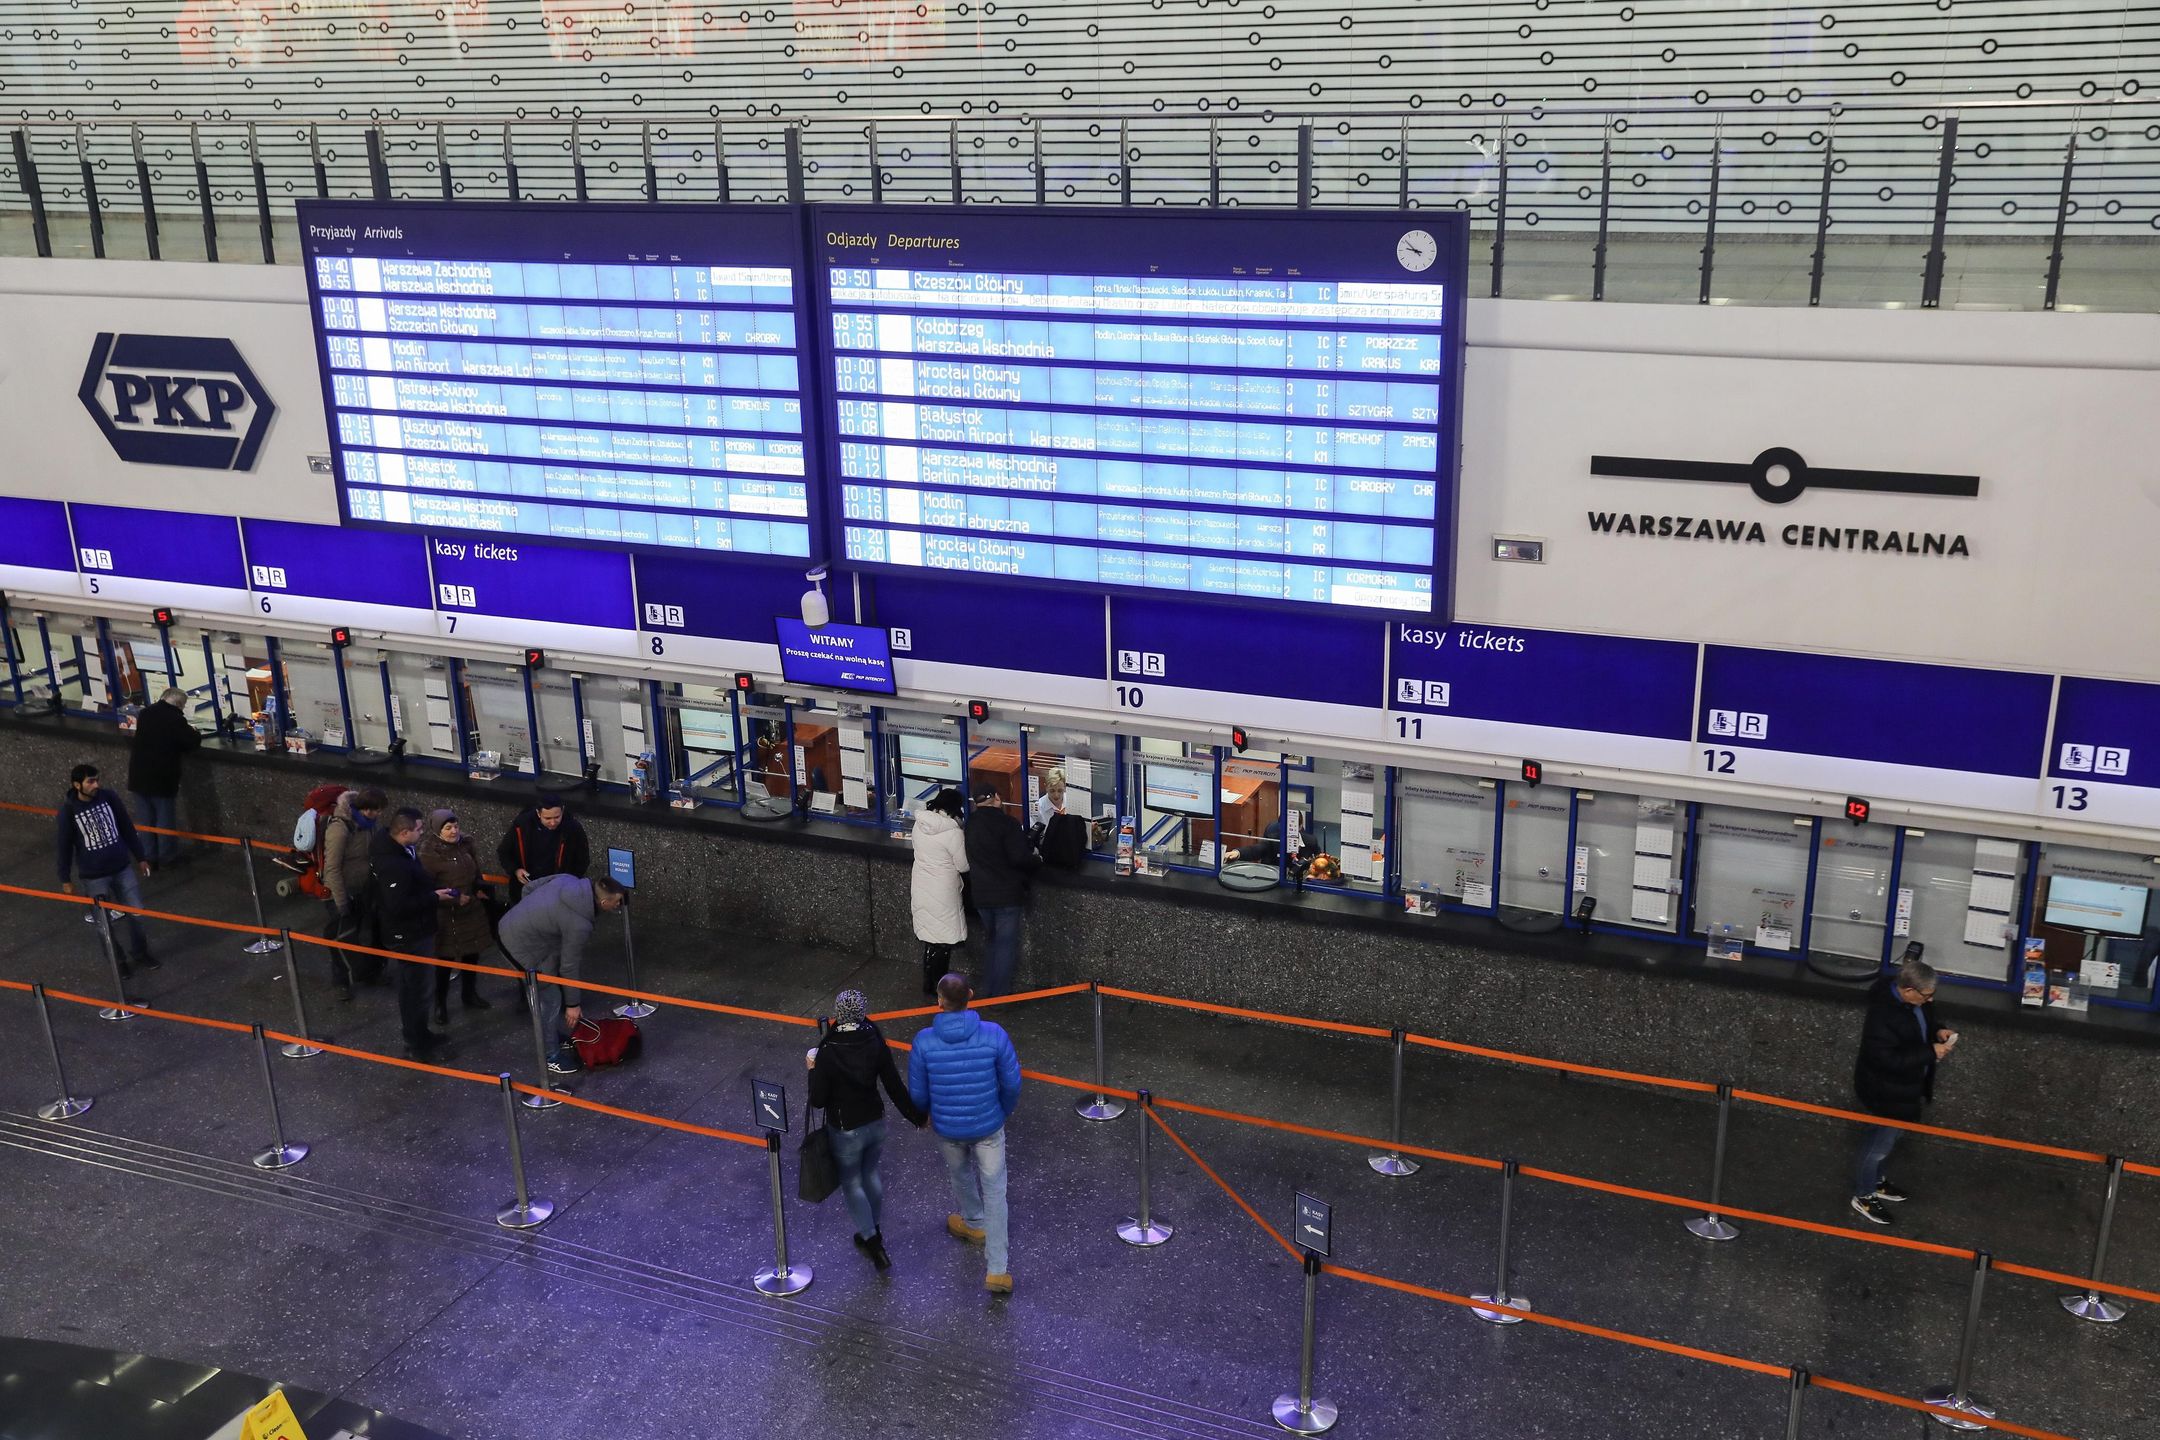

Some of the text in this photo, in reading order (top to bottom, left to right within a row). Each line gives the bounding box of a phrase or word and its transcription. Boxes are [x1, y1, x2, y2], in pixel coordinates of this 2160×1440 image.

[310, 225, 402, 240] Przyjazdy Arrivals
[827, 232, 960, 250] Odjazdy Departures
[316, 258, 491, 278] 09:40 Warszawa Zachodnia
[318, 274, 493, 294] 09:55 Warszawa Wschodnia
[832, 270, 870, 286] 09:50
[914, 272, 971, 290] Rzeszów
[976, 276, 1023, 294] Główny
[1318, 288, 1330, 300] IC
[322, 298, 496, 319] 10:00 Warszawa Wschodnia
[324, 314, 356, 328] 10:00
[390, 318, 438, 332] Szczecin
[440, 320, 478, 336] Główny
[833, 315, 872, 330] 09:55
[916, 318, 984, 338] Kołobrzeg
[1318, 336, 1330, 349] IC
[328, 337, 425, 355] 10:05 Modlin
[835, 333, 873, 348] 10:00
[917, 337, 978, 354] Warszawa
[983, 338, 1054, 358] Wschodnia
[330, 353, 361, 368] 10:06
[414, 358, 450, 374] Airport
[462, 360, 513, 376] Warszawa
[837, 358, 1020, 384] 10:00 Wrocław Główny
[334, 376, 364, 391] 10:10
[838, 376, 876, 392] 10:04
[919, 377, 970, 397] Wrocław
[974, 382, 1020, 402] Główny
[105, 373, 244, 430] PKP
[336, 392, 507, 416] 10:10 Warszawa Wschodnia
[839, 402, 876, 418] 10:05
[920, 407, 983, 426] Białystok
[339, 414, 482, 438] 10:15 Olsztyn Główny
[840, 418, 878, 434] 10:08
[921, 425, 964, 442] Chopin
[969, 426, 1014, 444] Airport
[1030, 430, 1094, 449] Warszawa
[341, 430, 372, 445] 10:15
[451, 437, 488, 454] Główny
[345, 452, 456, 474] 10:25 Białystok
[842, 444, 878, 460] 10:10
[922, 450, 983, 468] Warszawa
[987, 453, 1057, 473] Wschodnia
[346, 467, 377, 482] 10:30
[843, 461, 1057, 492] 10:12 Berlin Hauptbahnhof
[350, 490, 518, 516] 10:30 Warszawa Wschodnia
[844, 486, 881, 502] 10:15
[924, 492, 964, 510] Modlin
[352, 505, 502, 532] 10:35 Legionowo Piaski
[845, 503, 882, 520] 10:16
[959, 512, 1030, 532] Fabryczna
[846, 528, 884, 544] 10:20
[926, 534, 975, 552] Wrocław
[979, 540, 1024, 559] Główny
[1588, 512, 1969, 557] WARSZAWA CENTRALNA
[100, 553, 108, 564] R
[435, 539, 518, 561] kasy tickets
[848, 544, 884, 560] 10:20
[927, 552, 969, 570] Gdynia
[90, 578, 99, 594] 5
[274, 570, 282, 582] R
[261, 597, 271, 613] 6
[462, 588, 471, 601] R
[158, 612, 167, 622] 5
[446, 616, 456, 634] 7
[670, 608, 679, 621] R
[336, 630, 345, 641] 6
[652, 636, 664, 656] 8
[810, 634, 854, 648] WITAMY
[896, 630, 906, 644] R
[1400, 624, 1525, 653] kasy tickets
[530, 653, 539, 662] 7
[786, 648, 809, 658] Proszę
[810, 652, 834, 660] czekać
[845, 656, 866, 665] wolną
[1148, 656, 1159, 670] R
[1116, 686, 1144, 708] 10
[1431, 684, 1443, 700] R
[974, 705, 982, 716] 9
[1396, 717, 1422, 740] 11
[1746, 716, 1760, 732] R
[1234, 732, 1242, 744] 10
[1704, 749, 1736, 774] 12
[2104, 750, 2120, 768] R
[1526, 766, 1536, 778] 11
[2052, 786, 2088, 810] 13
[1848, 802, 1866, 818] 12
